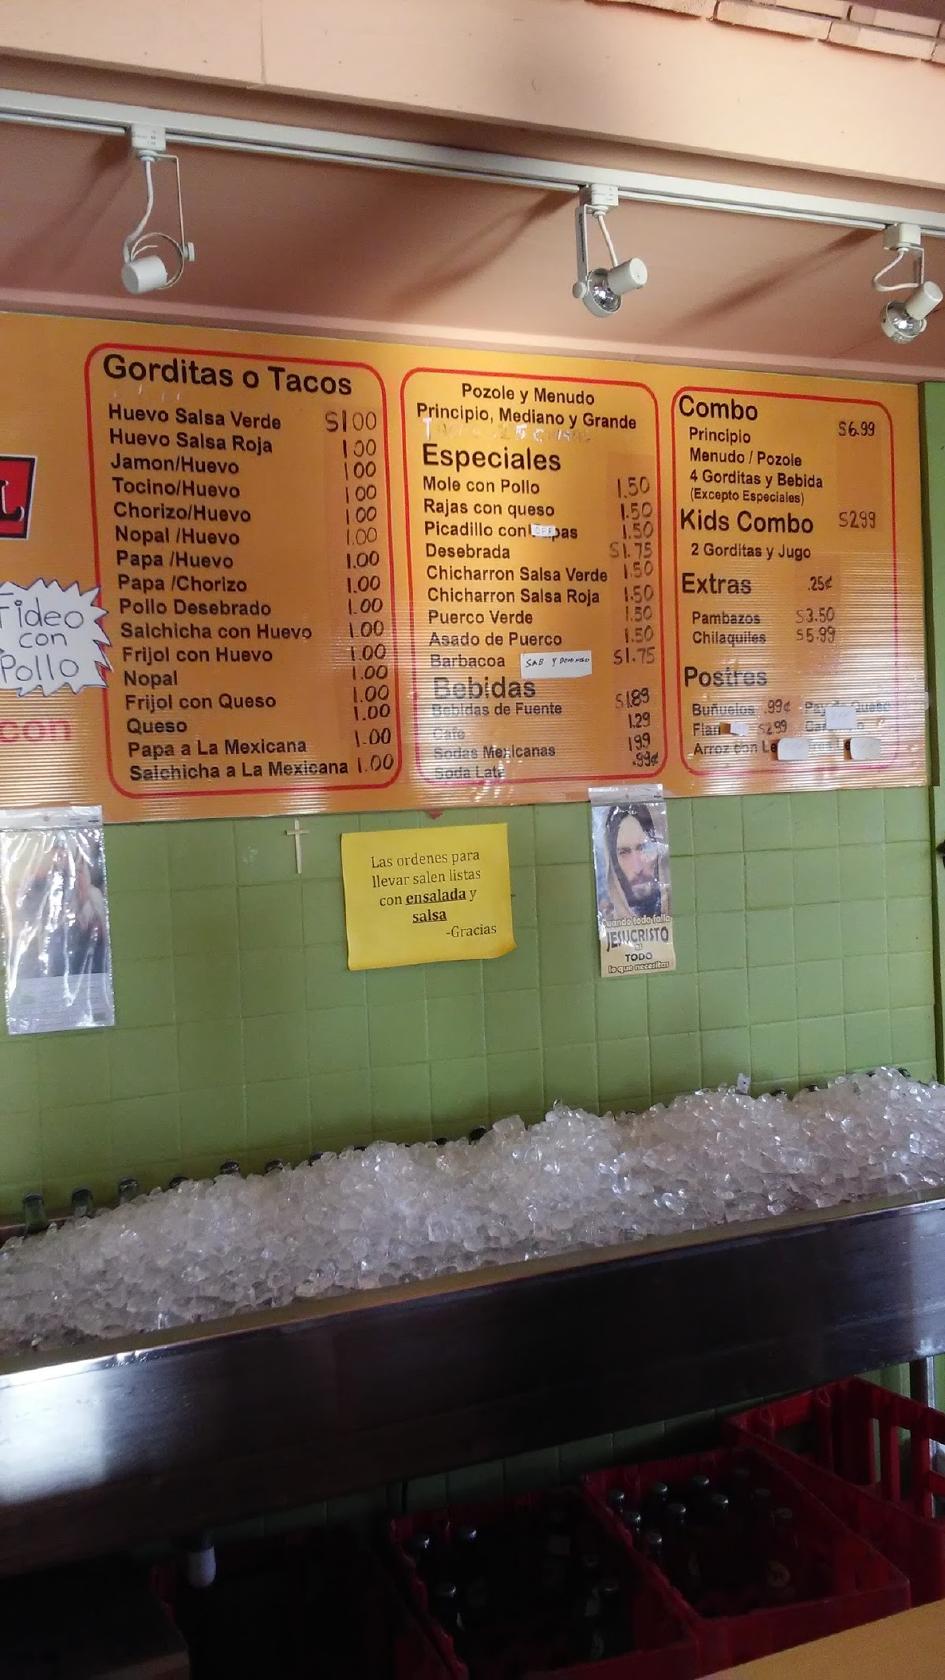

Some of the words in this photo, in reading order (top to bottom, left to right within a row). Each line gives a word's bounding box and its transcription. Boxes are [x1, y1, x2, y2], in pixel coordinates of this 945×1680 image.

[103, 354, 233, 387] Gorditas
[242, 371, 259, 388] o
[268, 367, 352, 395] Tacos
[462, 383, 515, 400] Pozole
[520, 390, 528, 402] y
[534, 388, 594, 405] Menudo
[417, 403, 493, 424] Principio,
[500, 408, 564, 425] Mediano
[570, 415, 577, 429] y
[583, 413, 636, 429] Grande
[679, 394, 758, 421] Combo
[109, 404, 169, 422] Huevo
[176, 408, 225, 426] Salsa
[231, 411, 281, 430] Verde
[110, 428, 170, 447] Huevo
[177, 432, 226, 450] Salsa
[233, 436, 272, 456] Roja
[689, 427, 750, 445] Principio
[111, 454, 239, 474] Jamon/Huevo
[423, 443, 561, 472] Especiales
[690, 448, 745, 464] Menudo
[758, 451, 802, 466] Pozole
[112, 477, 240, 498] Tocino/Huevo
[423, 476, 460, 492] Mole
[466, 480, 494, 492] con
[501, 480, 539, 494] Pollo
[690, 469, 697, 482] 4
[703, 469, 761, 485] Gorditas
[766, 475, 772, 488] y
[778, 473, 823, 488] Bebida
[691, 488, 739, 503] (Excepto
[743, 490, 804, 506] Especiales)
[114, 502, 251, 522] Chorizo/Huevo
[424, 499, 468, 519] Rajas
[474, 502, 502, 515] con
[508, 504, 554, 519] queso
[425, 521, 492, 537] Picadillo
[499, 525, 527, 538] con
[681, 509, 729, 531] Kids
[737, 510, 813, 534] Combo
[115, 526, 169, 546] Nopal
[176, 528, 240, 545] /Huevo
[117, 550, 162, 570] Papa
[170, 552, 233, 568] /Huevo
[426, 543, 510, 559] Desebrada
[691, 543, 698, 555] 2
[704, 543, 762, 557] Gorditas
[767, 546, 774, 559] y
[778, 544, 811, 559] Jugo
[427, 565, 514, 580] Chicharron
[520, 567, 561, 581] Salsa
[566, 568, 608, 582] Verde
[118, 575, 165, 594] Papa
[171, 576, 247, 593] /Chorizo
[682, 573, 751, 594] Extras
[428, 588, 515, 603] Chicharron
[521, 589, 561, 603] Salsa
[567, 589, 600, 606] Roja
[120, 598, 166, 615] Pollo
[174, 599, 271, 616] Desebrado
[429, 610, 484, 624] Puerco
[490, 610, 533, 624] Verde
[692, 611, 760, 625] Pambazos
[19, 631, 68, 649] con
[121, 623, 212, 639] Salchicha
[219, 626, 250, 639] con
[257, 624, 312, 640] Huevo
[429, 632, 480, 647] Asado
[485, 632, 503, 646] de
[509, 631, 562, 645] Puerco
[693, 631, 766, 647] Chilaquiles
[123, 646, 169, 665] Frijol
[177, 649, 209, 662] con
[216, 647, 273, 662] Huevo
[431, 654, 505, 668] Barbacoa
[1, 654, 79, 684] Pollo
[684, 666, 767, 687] Postres
[124, 671, 177, 689] Nopal
[434, 677, 536, 699] Bebidas
[126, 694, 172, 713] Frijol
[180, 696, 212, 709] con
[219, 693, 276, 708] Queso
[495, 703, 510, 715] de
[516, 702, 562, 715] Fuente
[692, 703, 755, 715] Buñuelos
[127, 718, 187, 735] Queso
[129, 741, 174, 759] Papa
[181, 744, 191, 755] a
[198, 740, 218, 755] La
[225, 738, 307, 754] Mexicana
[484, 744, 555, 758] Mexicanas
[693, 742, 730, 755] Arroz
[735, 743, 757, 754] con
[227, 766, 236, 778] a
[243, 763, 263, 777] La
[269, 760, 348, 776] Mexicana
[371, 856, 393, 868] Las
[397, 852, 448, 867] ordenes
[451, 849, 480, 867] para
[372, 874, 409, 888] llevar
[413, 871, 446, 884] salen
[449, 868, 481, 882] listas
[379, 894, 403, 907] con
[406, 889, 466, 906] ensalada
[469, 891, 477, 903] y
[412, 910, 447, 924] salsa
[446, 925, 496, 938] -Gracias
[607, 927, 669, 951] JESUCRISTO
[625, 952, 652, 962] TODO
[608, 965, 616, 973] lo
[618, 965, 633, 973] que
[635, 961, 669, 971] necesitas
